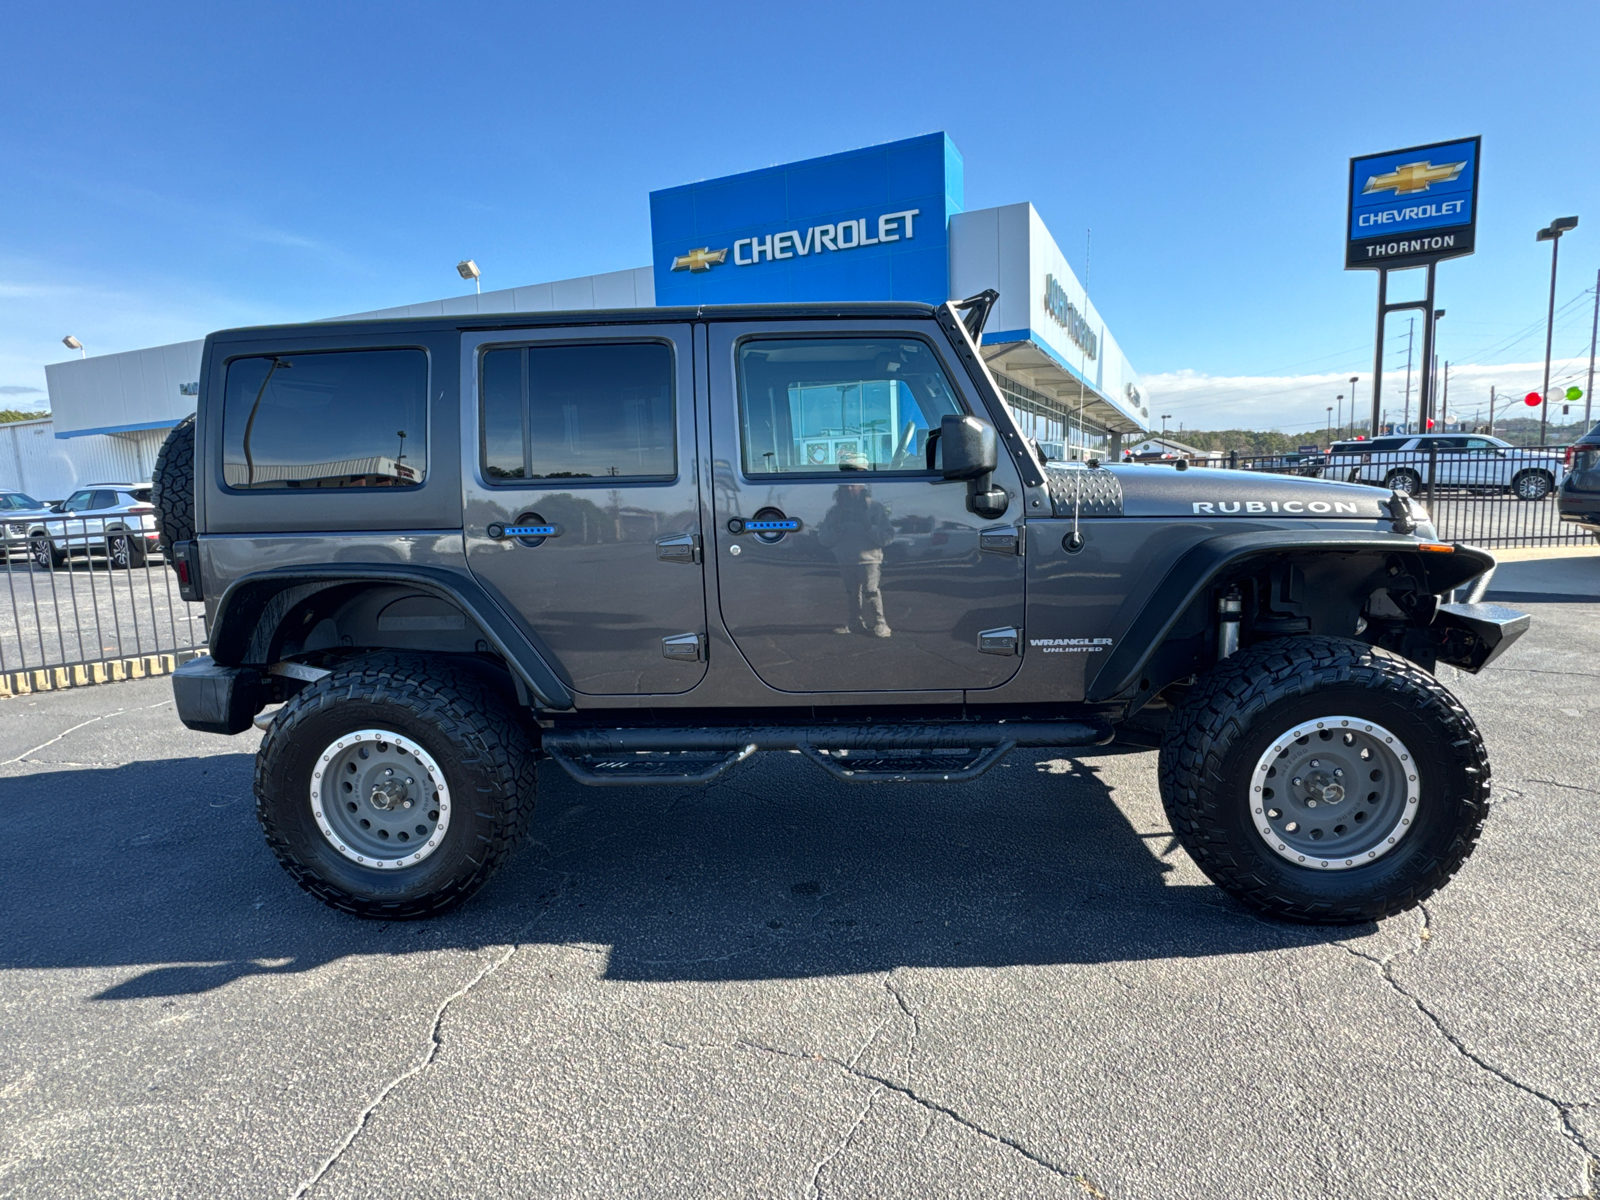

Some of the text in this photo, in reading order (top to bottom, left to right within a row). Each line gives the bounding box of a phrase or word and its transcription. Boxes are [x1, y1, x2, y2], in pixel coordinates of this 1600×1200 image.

[1358, 199, 1465, 227] CHEVROLET
[734, 209, 919, 266] CHEVROLET
[1366, 235, 1455, 257] THORNTON
[1192, 501, 1358, 514] RUBICON
[1030, 638, 1113, 646] WRANGLER
